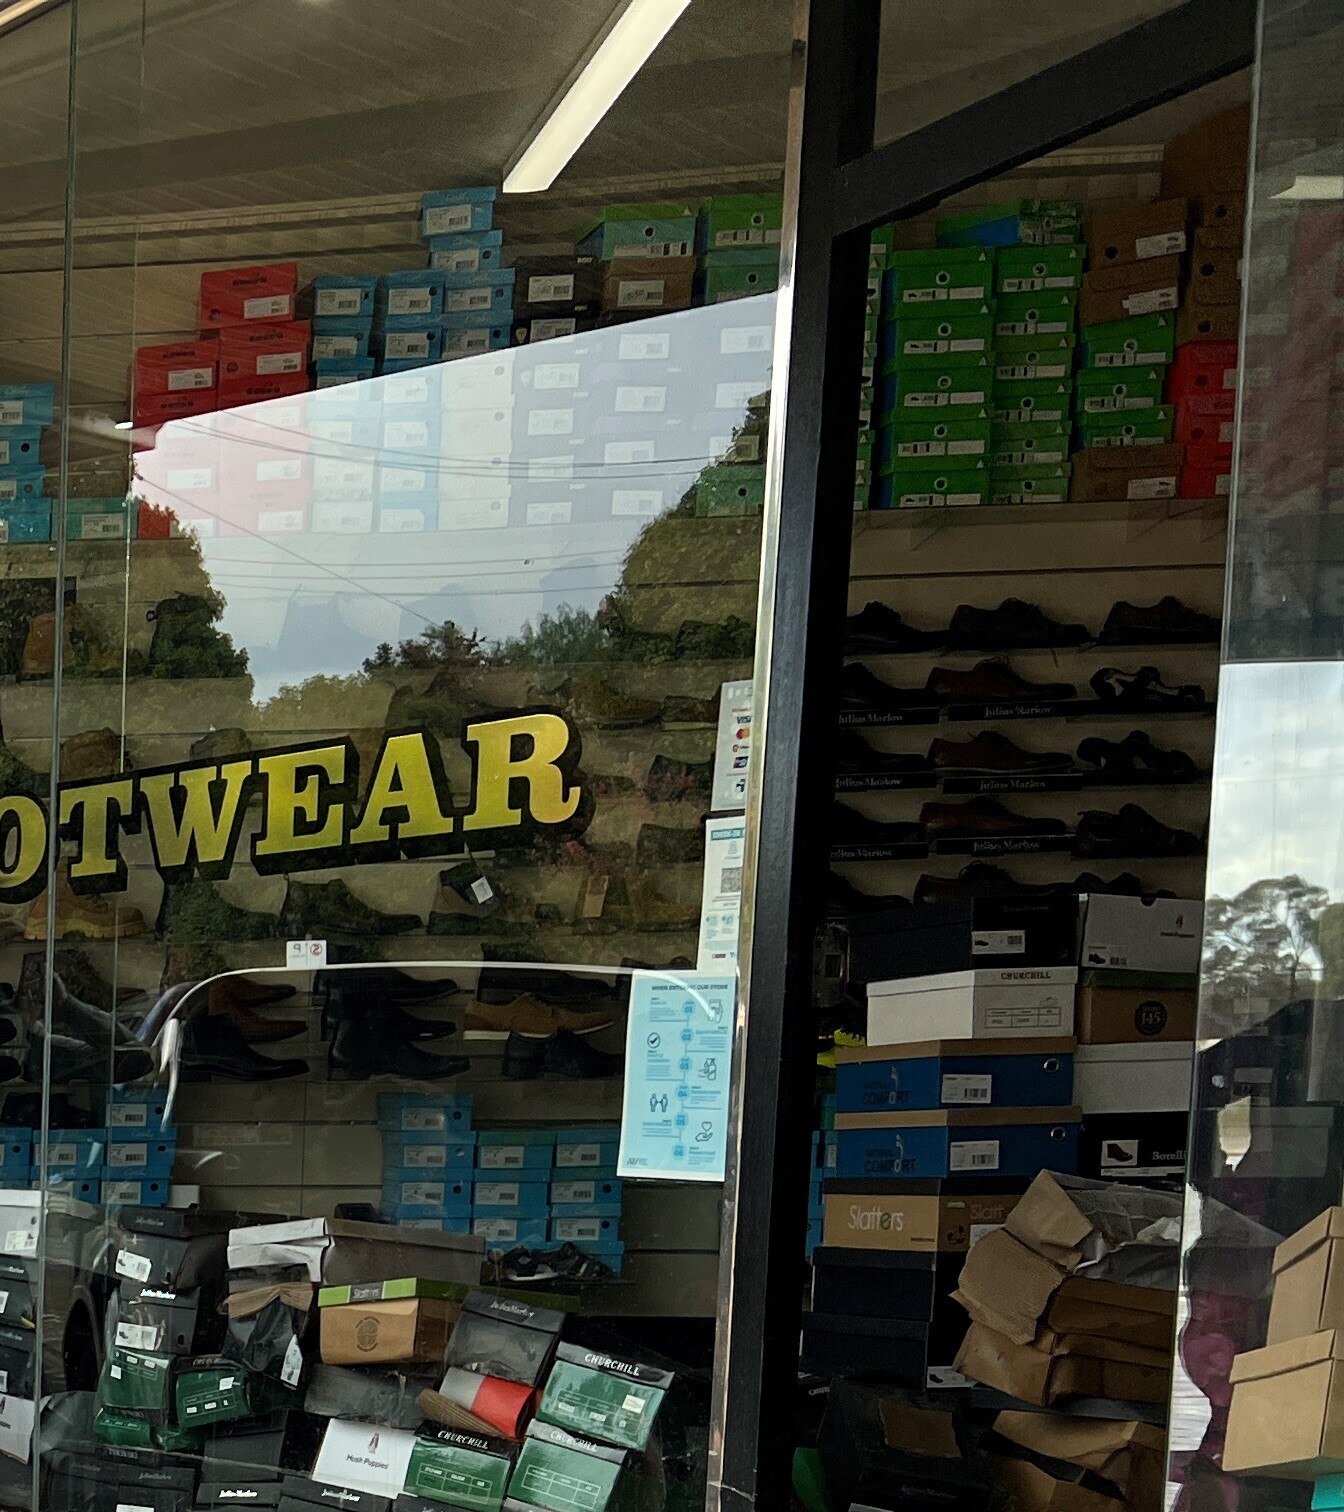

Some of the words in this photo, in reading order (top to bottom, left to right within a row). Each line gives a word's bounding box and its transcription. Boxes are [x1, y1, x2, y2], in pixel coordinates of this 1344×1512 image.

[848, 1204, 904, 1232] Slatters
[353, 1288, 380, 1299] Slattrs
[584, 1353, 640, 1377] CHURCHILL
[437, 1430, 489, 1451] CHURCHILL
[550, 1430, 598, 1453] CHURCHILL
[346, 1454, 363, 1466] Hush
[363, 1457, 389, 1470] Puppies
